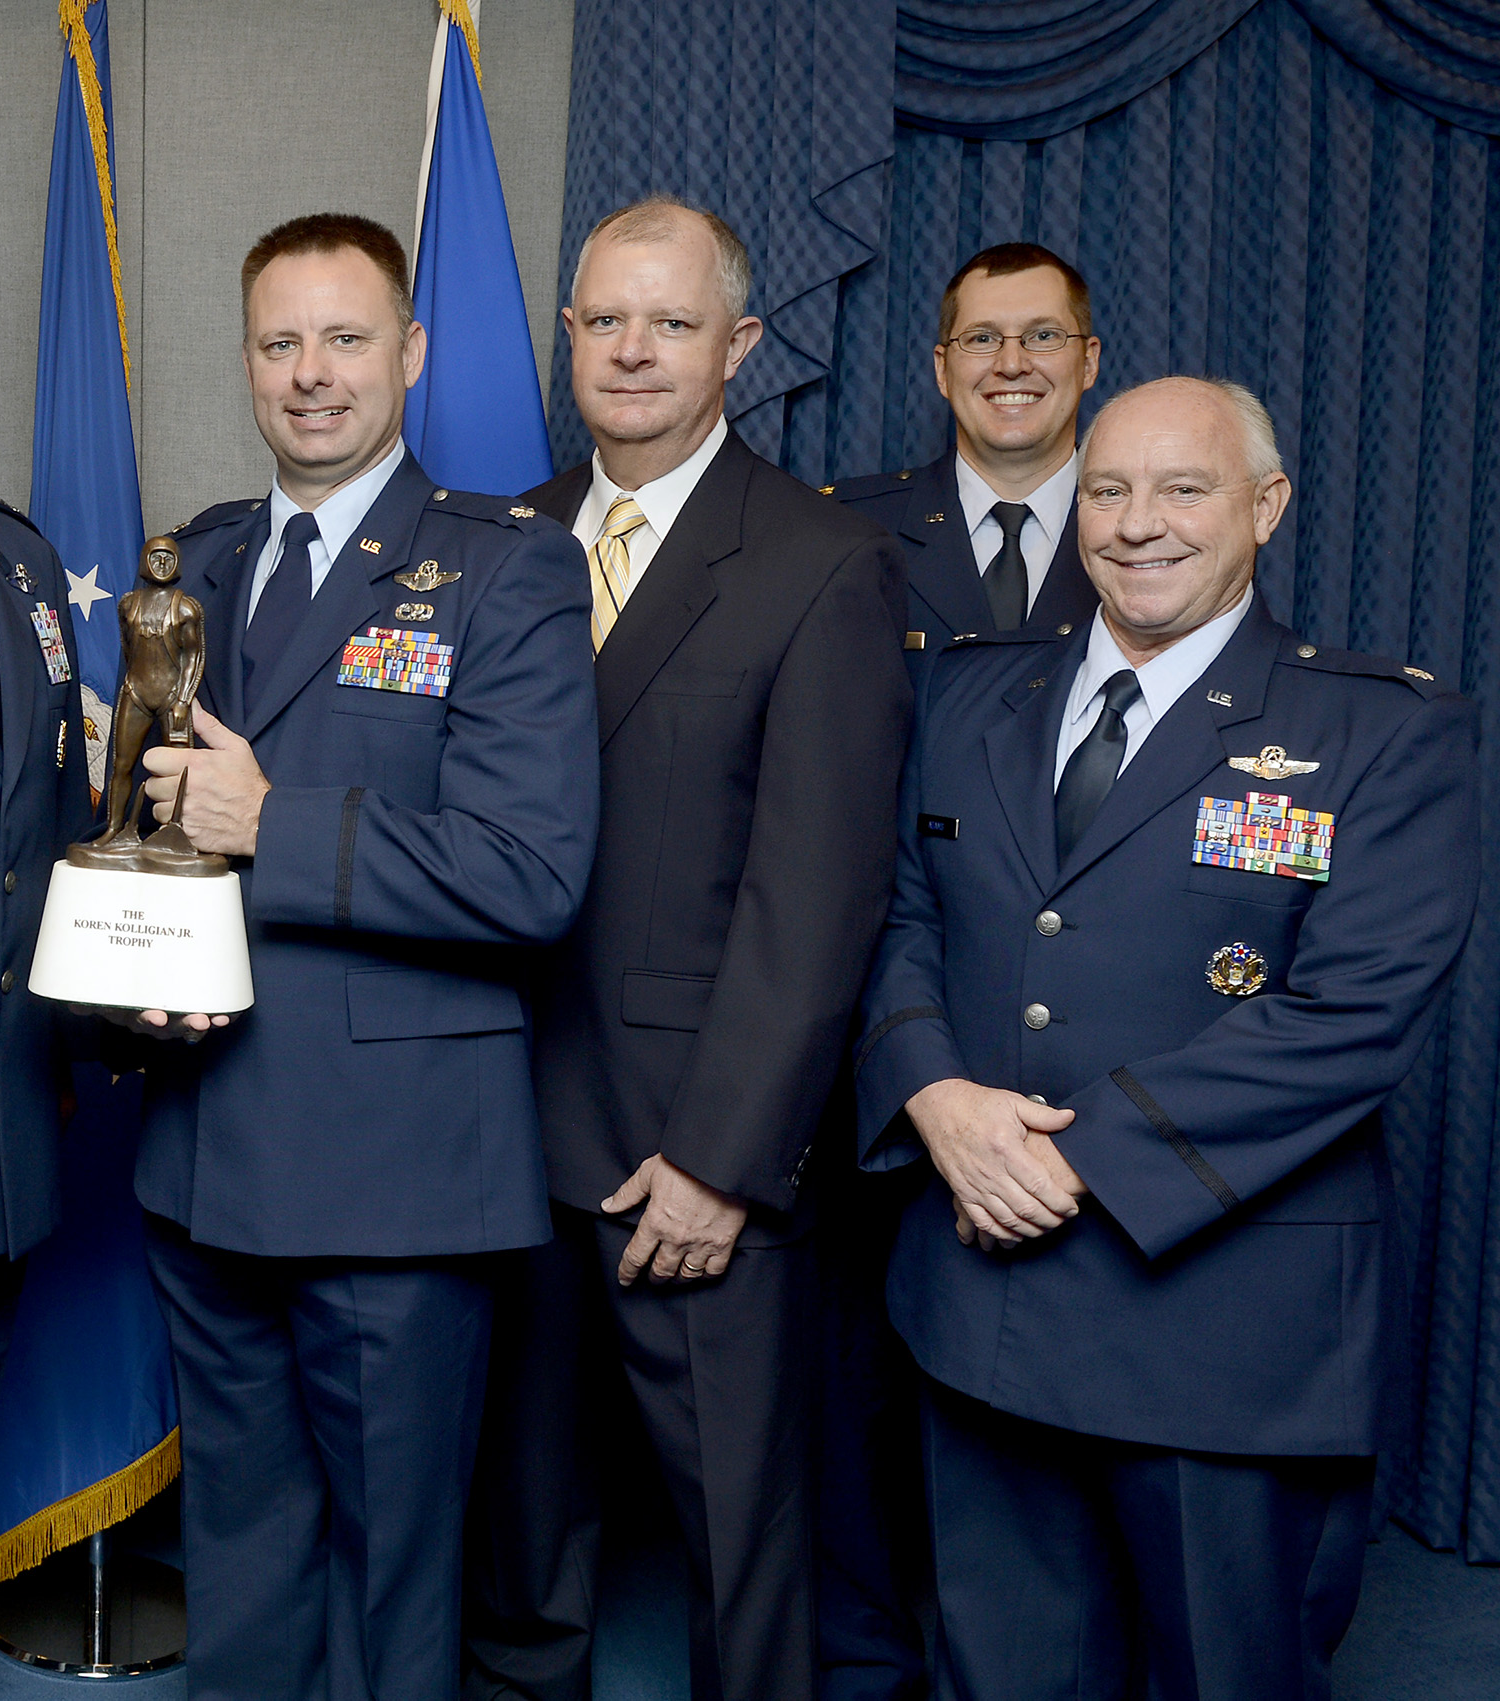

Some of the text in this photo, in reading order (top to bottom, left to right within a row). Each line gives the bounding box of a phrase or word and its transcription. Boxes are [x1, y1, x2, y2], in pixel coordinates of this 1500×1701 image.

[121, 909, 145, 920] THE
[74, 919, 194, 938] KOREN KOLLIGIAN JR.
[108, 935, 154, 948] TROPHY
